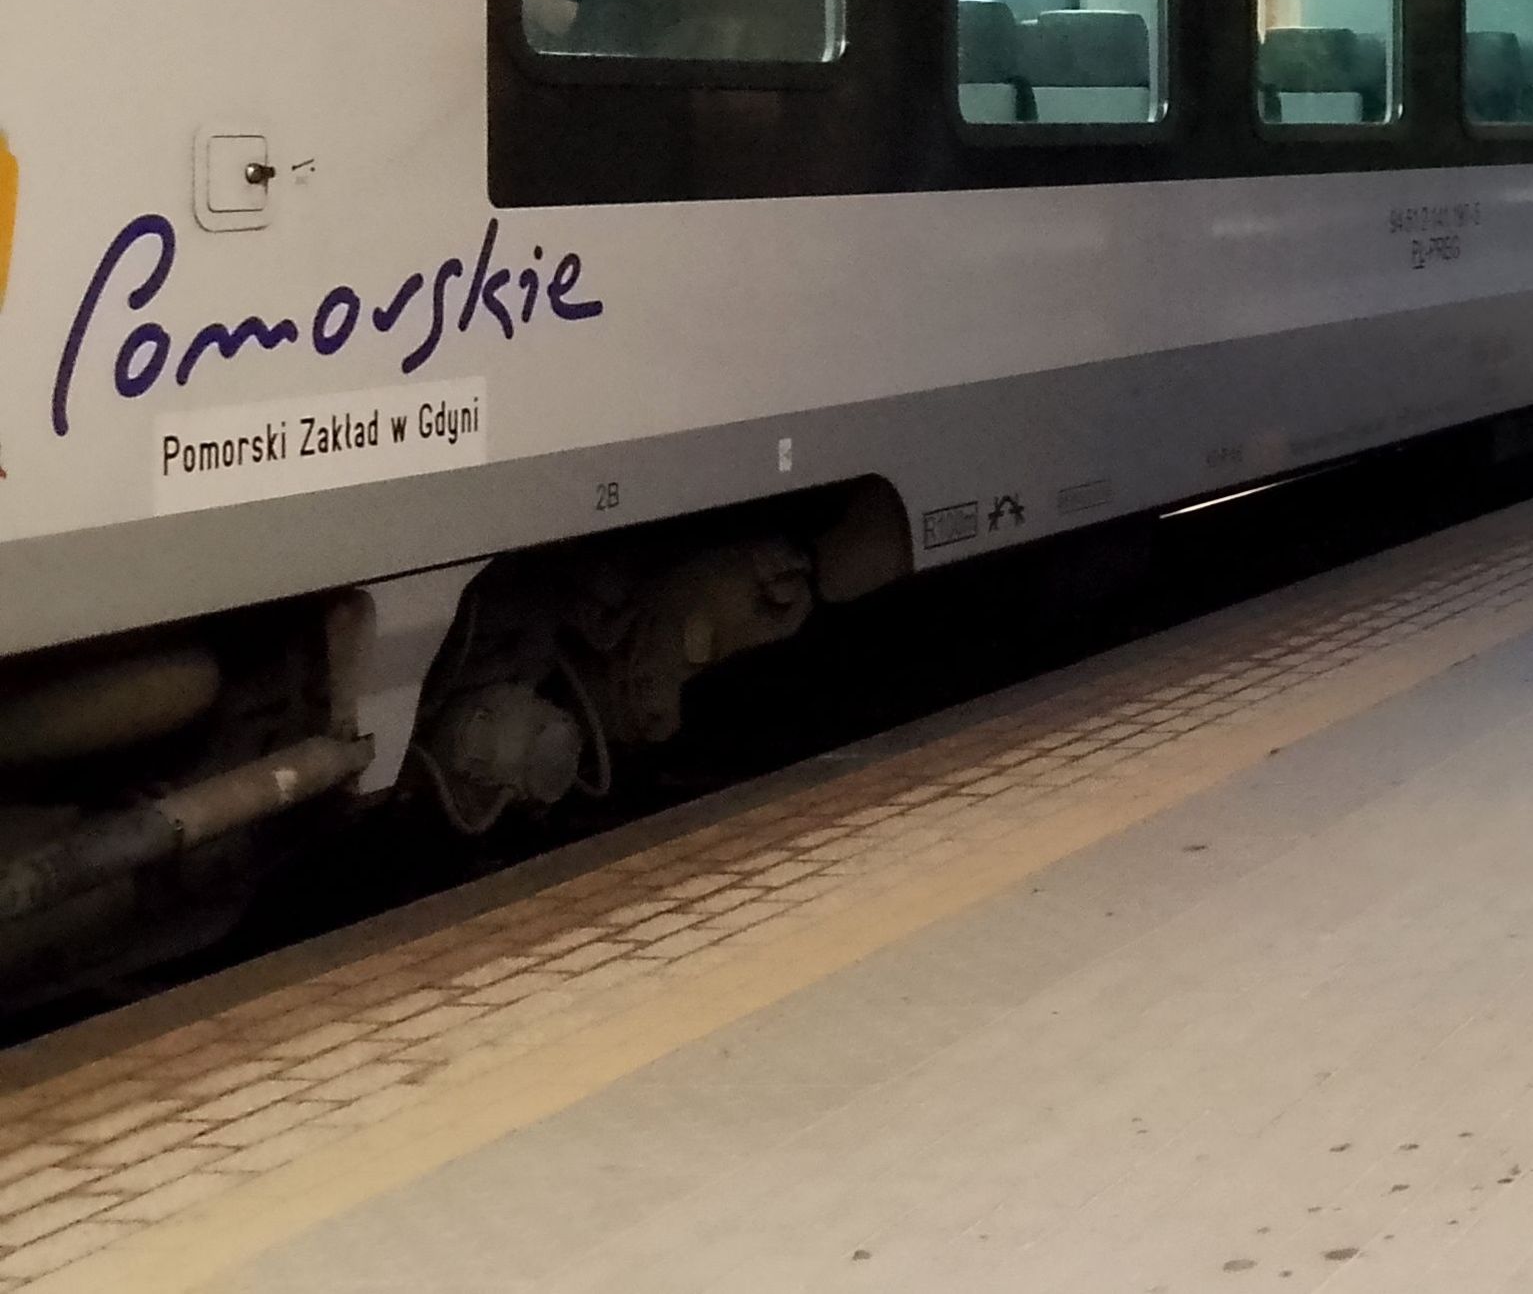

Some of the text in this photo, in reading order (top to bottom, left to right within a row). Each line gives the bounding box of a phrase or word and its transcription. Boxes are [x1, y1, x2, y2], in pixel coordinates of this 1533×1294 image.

[51, 214, 604, 437] Pomorskie
[162, 396, 480, 477] Pomorski Zakład w Gdyni
[594, 481, 621, 514] 2B
